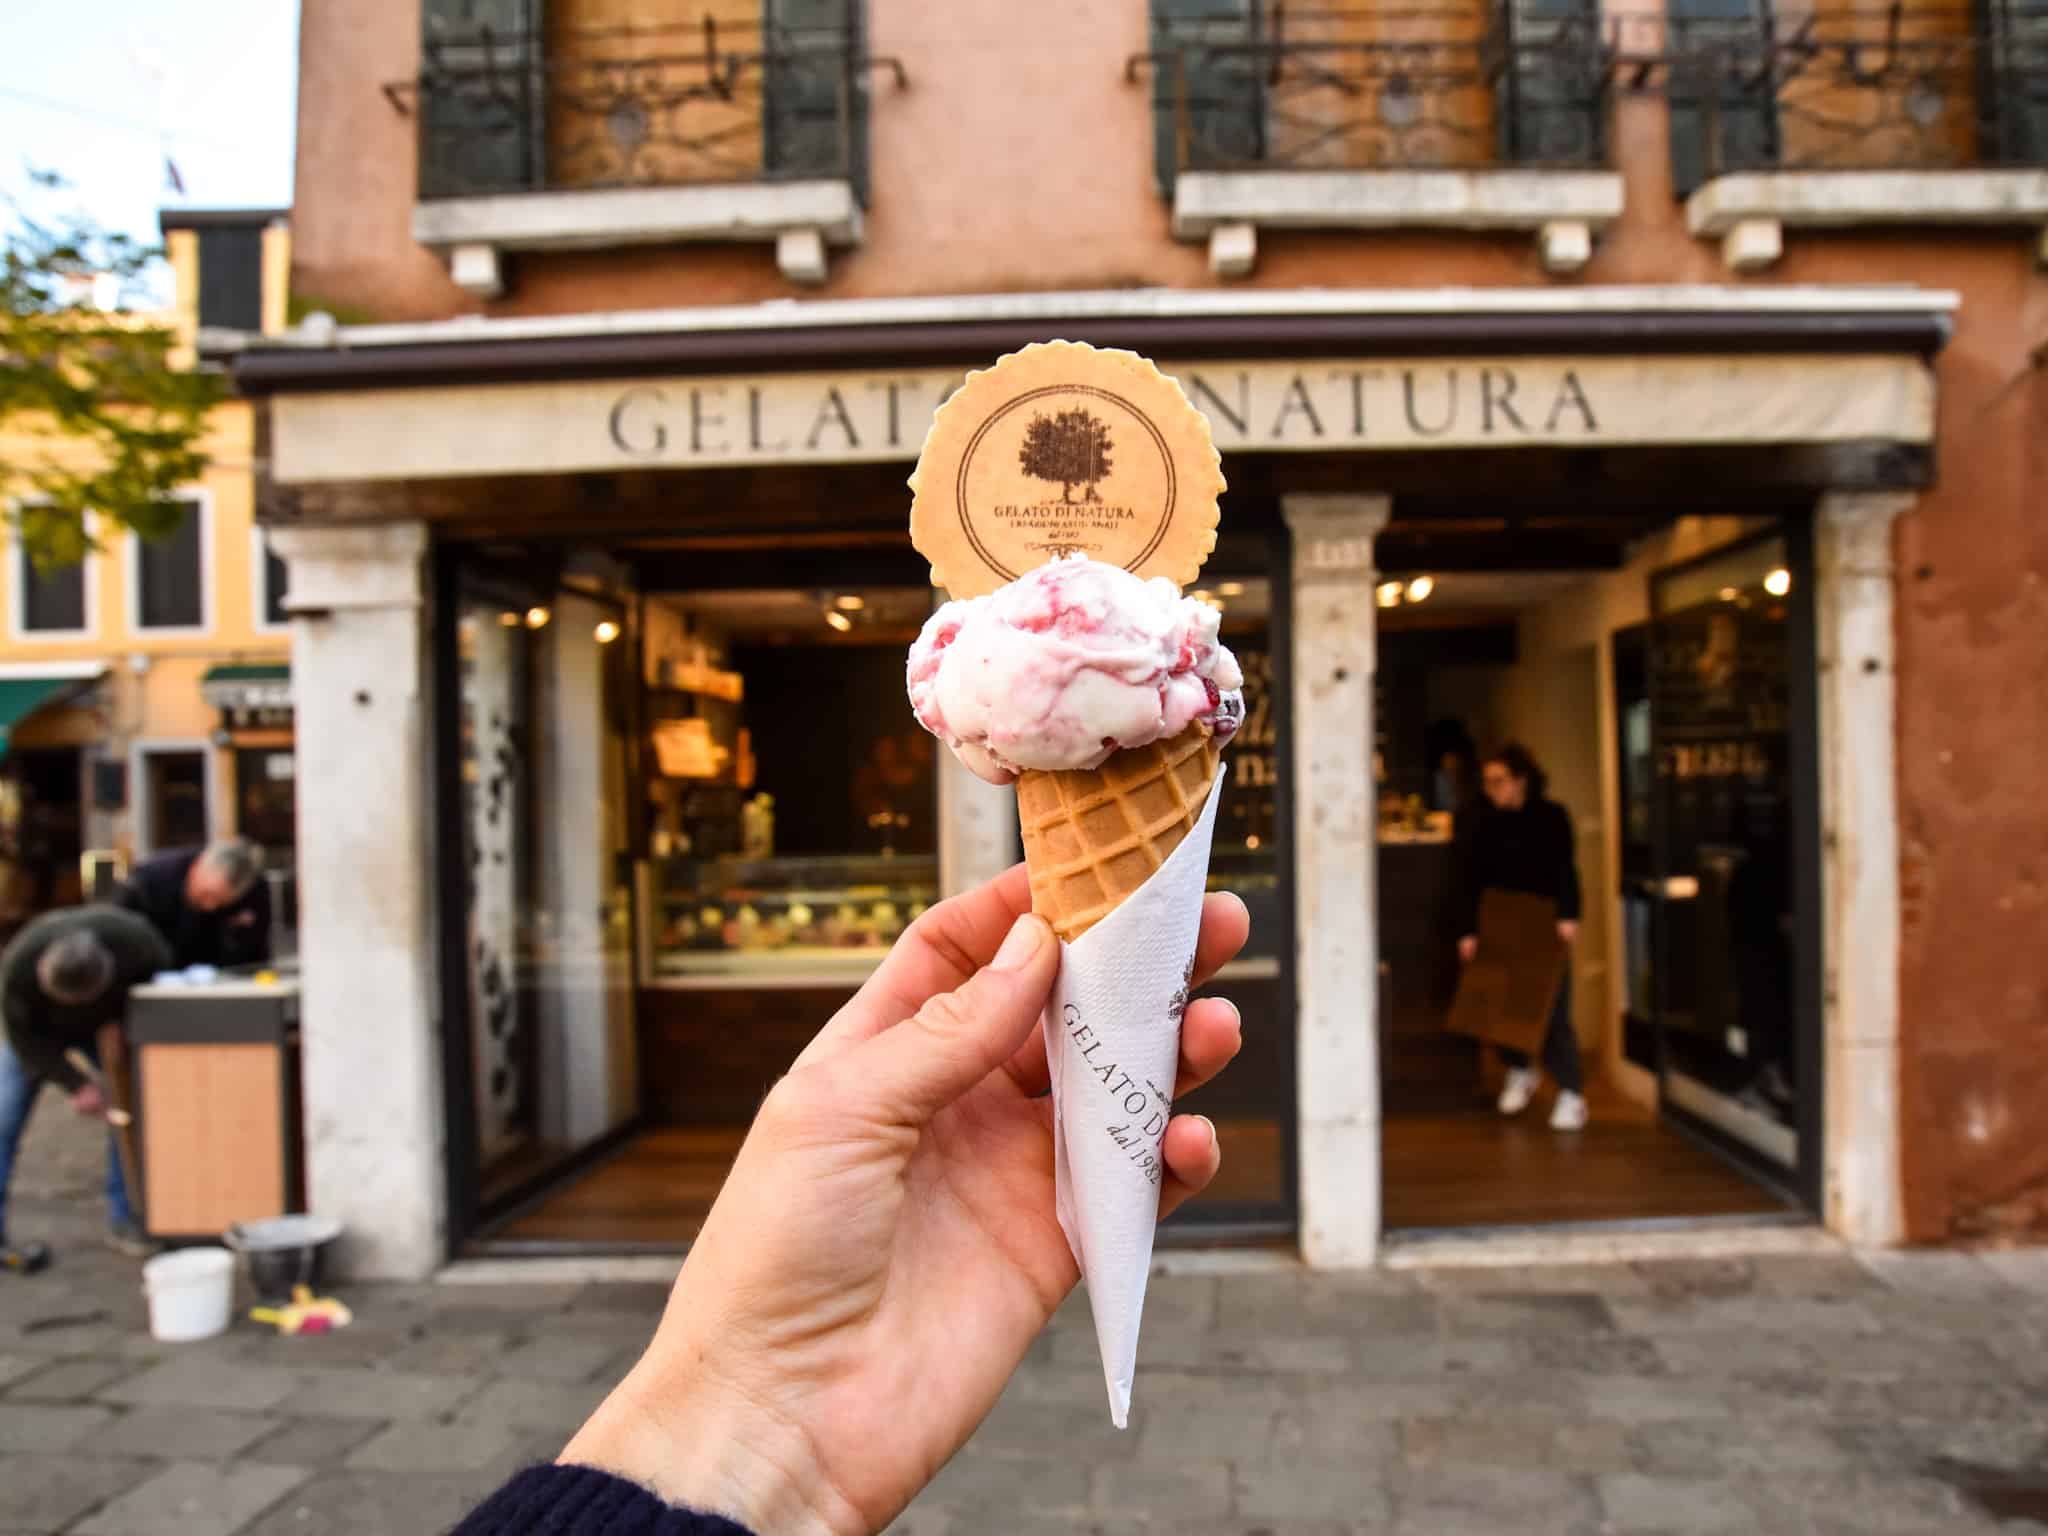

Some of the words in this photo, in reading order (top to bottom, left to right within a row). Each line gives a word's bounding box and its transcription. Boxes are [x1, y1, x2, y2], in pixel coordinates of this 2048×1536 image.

[609, 380, 955, 455] GELAT
[1188, 367, 1601, 435] NATURA
[994, 506, 1051, 518] GELATO
[1055, 507, 1070, 518] DI
[1074, 507, 1135, 519] NATURA
[1063, 1003, 1147, 1114] GELATO
[1106, 1124, 1141, 1150] dal
